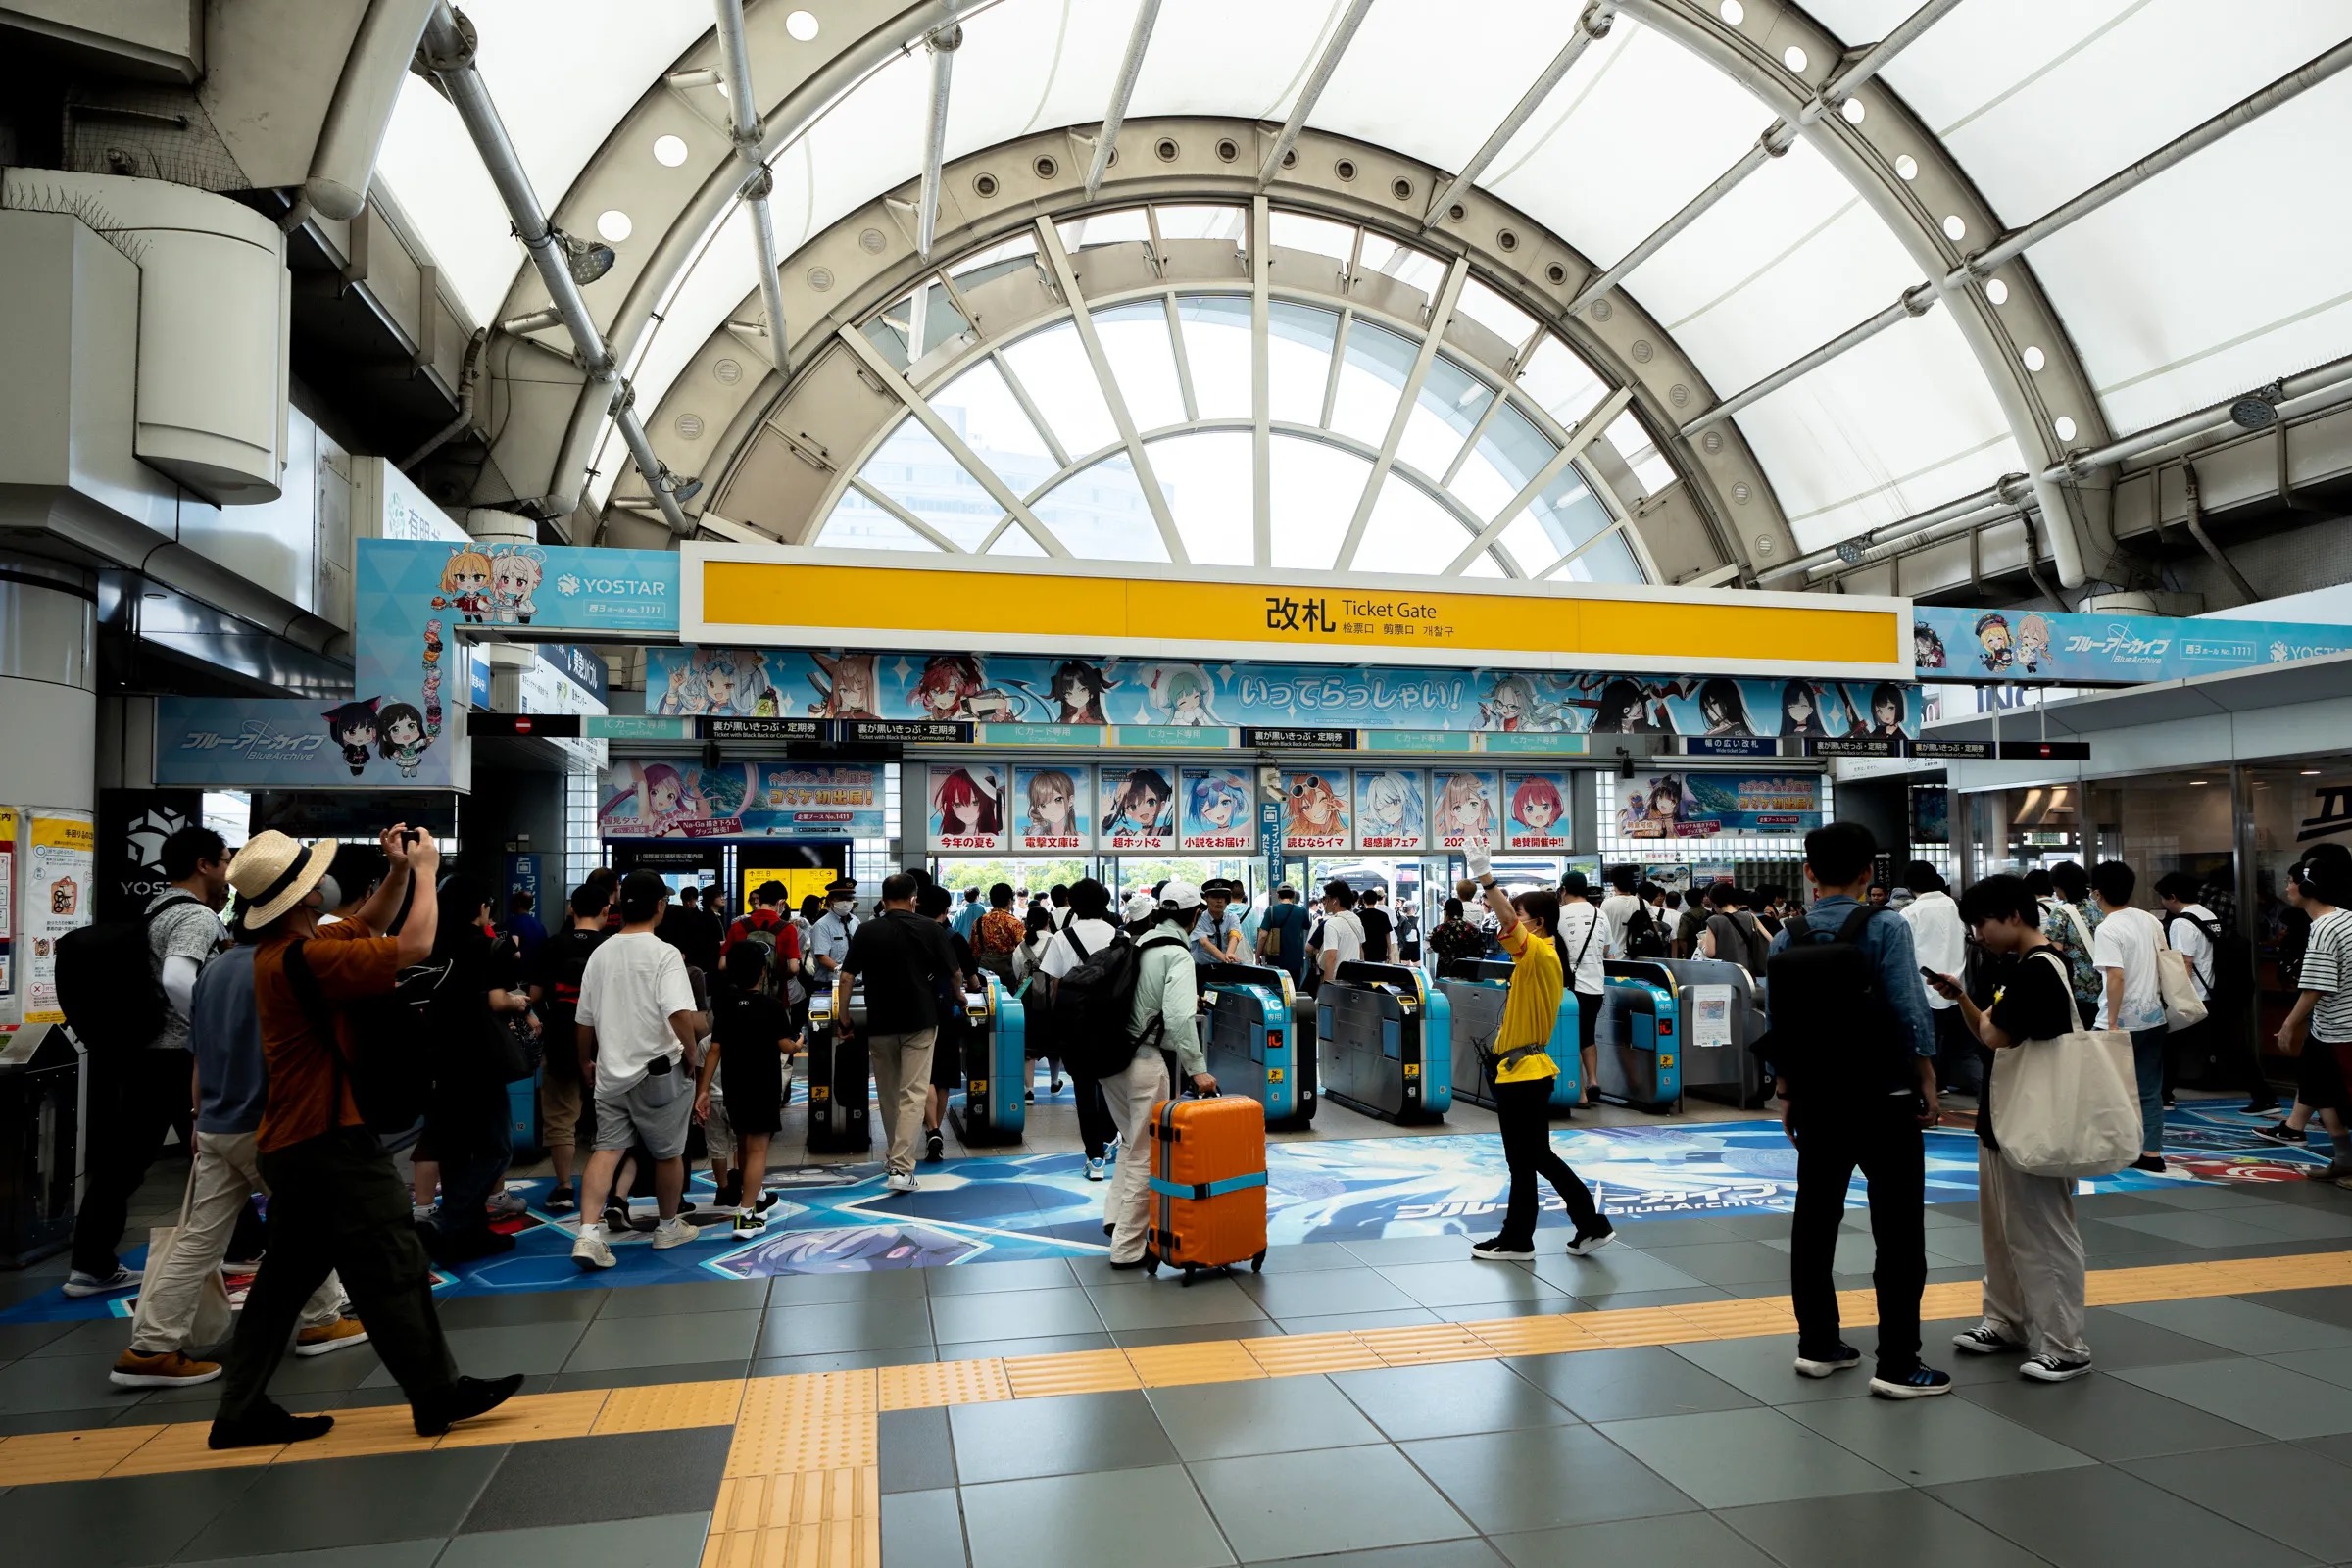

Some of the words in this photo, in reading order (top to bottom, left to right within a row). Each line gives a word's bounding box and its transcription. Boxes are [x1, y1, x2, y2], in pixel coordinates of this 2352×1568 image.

[584, 579, 665, 596] YOSTAR
[1265, 597, 1337, 633] 改札
[1342, 600, 1394, 617] Ticket
[1397, 602, 1437, 619] Gate
[1384, 624, 1414, 635] 剪票口
[1423, 626, 1454, 637] 개찰구
[2065, 635, 2172, 655] ブルーアーカイブ
[1241, 676, 1465, 711] いってらっしゃい!
[713, 721, 816, 733] 裏が黒いきっぷ・定期券
[858, 723, 957, 735] 裏が黒いきっぷ・定期券
[180, 733, 327, 751] ブルーアーカイブ
[1254, 731, 1343, 742] 裏が黒いきっぷ・定期券
[941, 837, 996, 848] 今年の夏も
[1024, 837, 1080, 848] 電撃文庫は
[1112, 837, 1161, 848] 超ホットな
[1184, 837, 1250, 848] 小説をお届け!
[1287, 837, 1345, 848] 読むならイマ
[1362, 837, 1419, 848] 超感謝フェア
[1512, 837, 1564, 848] 絶賛開催中!!
[1652, 990, 1672, 1002] IC
[1264, 999, 1283, 1011] IC
[1267, 1013, 1282, 1022] 専用
